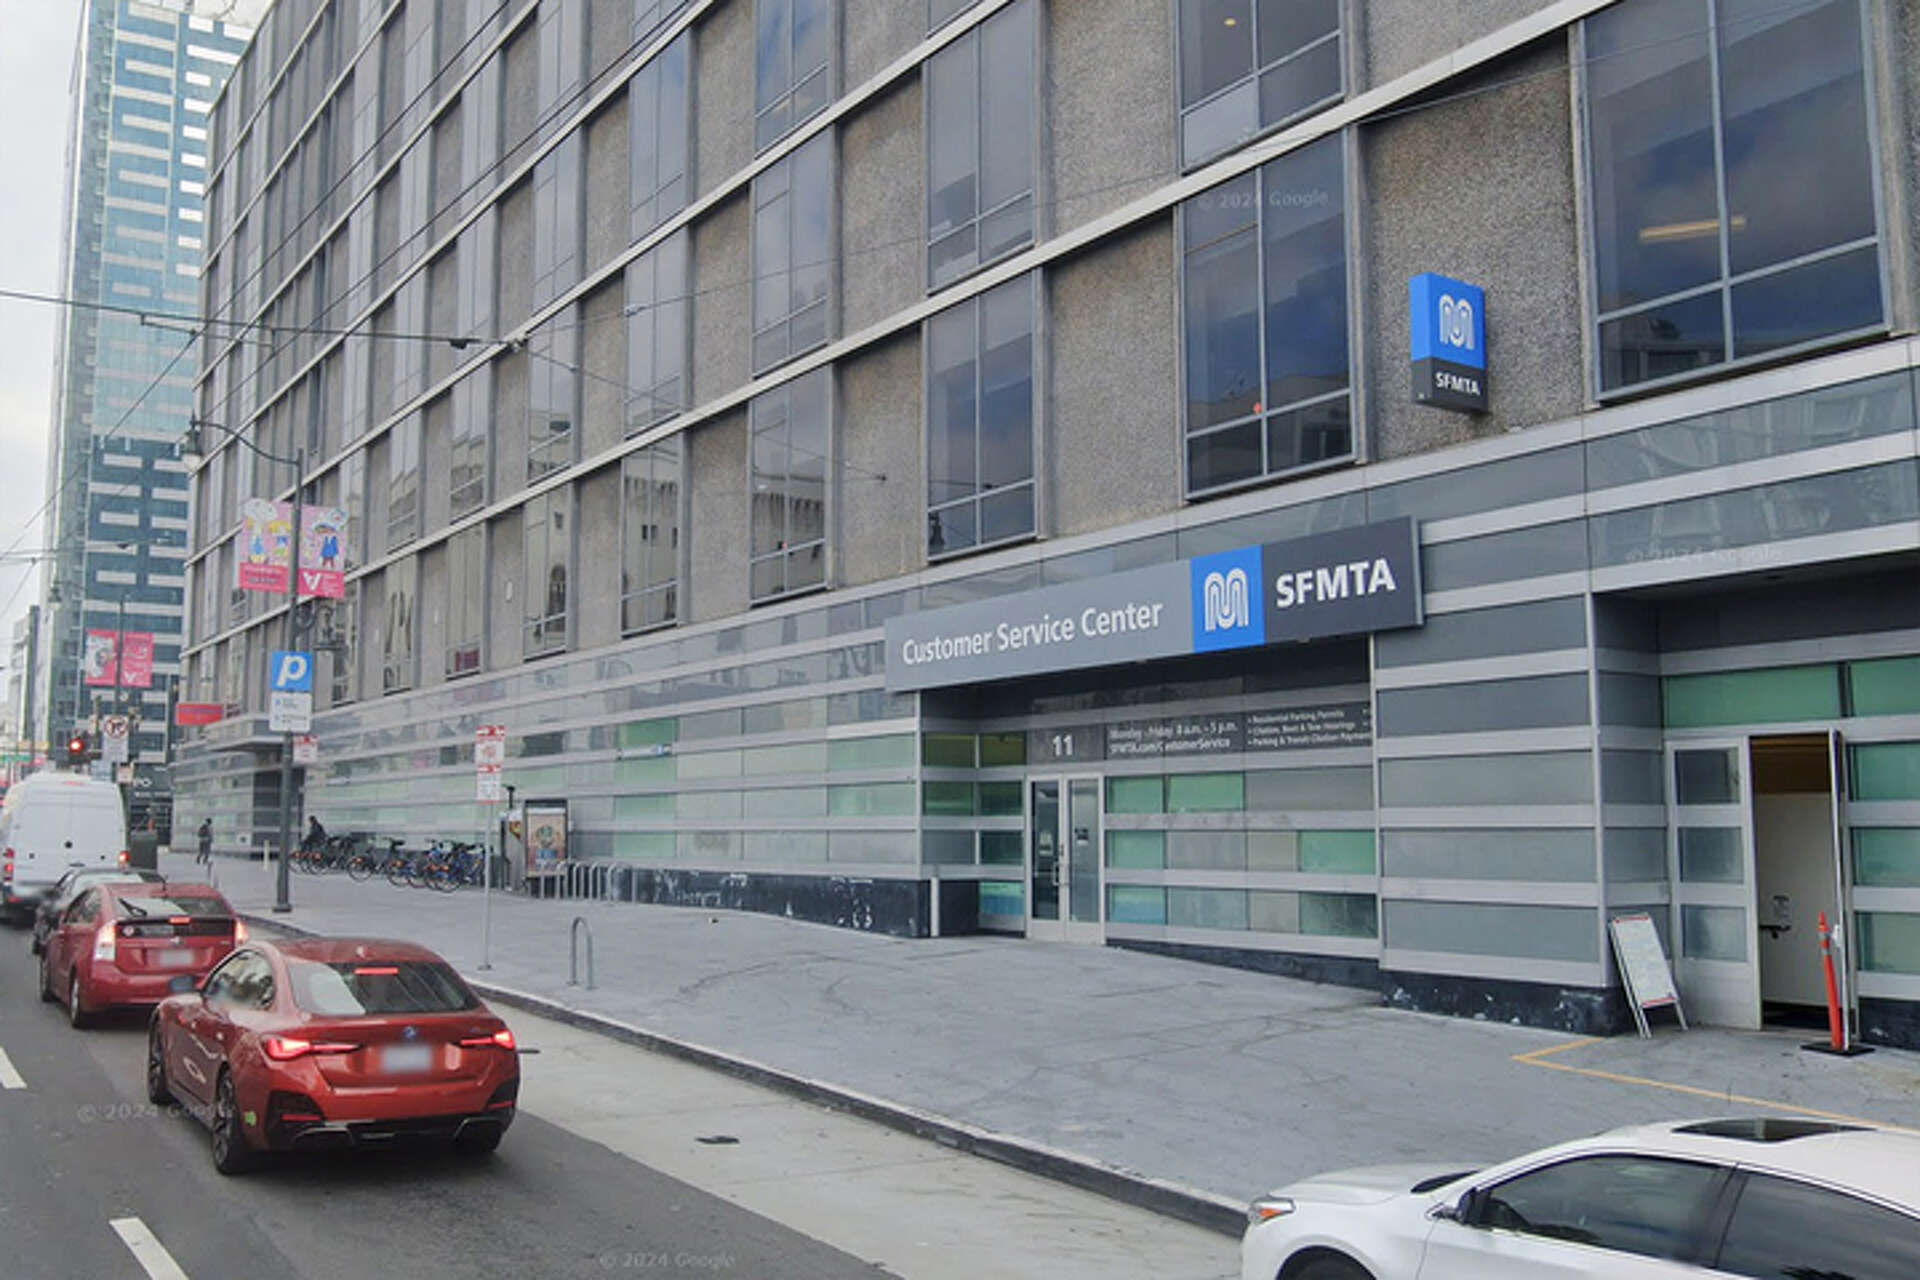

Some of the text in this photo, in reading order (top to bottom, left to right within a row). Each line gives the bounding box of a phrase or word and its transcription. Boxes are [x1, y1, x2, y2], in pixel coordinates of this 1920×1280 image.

[1435, 371, 1481, 396] SFMTA
[1275, 557, 1397, 608] SFMTA
[902, 602, 1163, 665] Customer Service Center
[1052, 735, 1073, 757] 11
